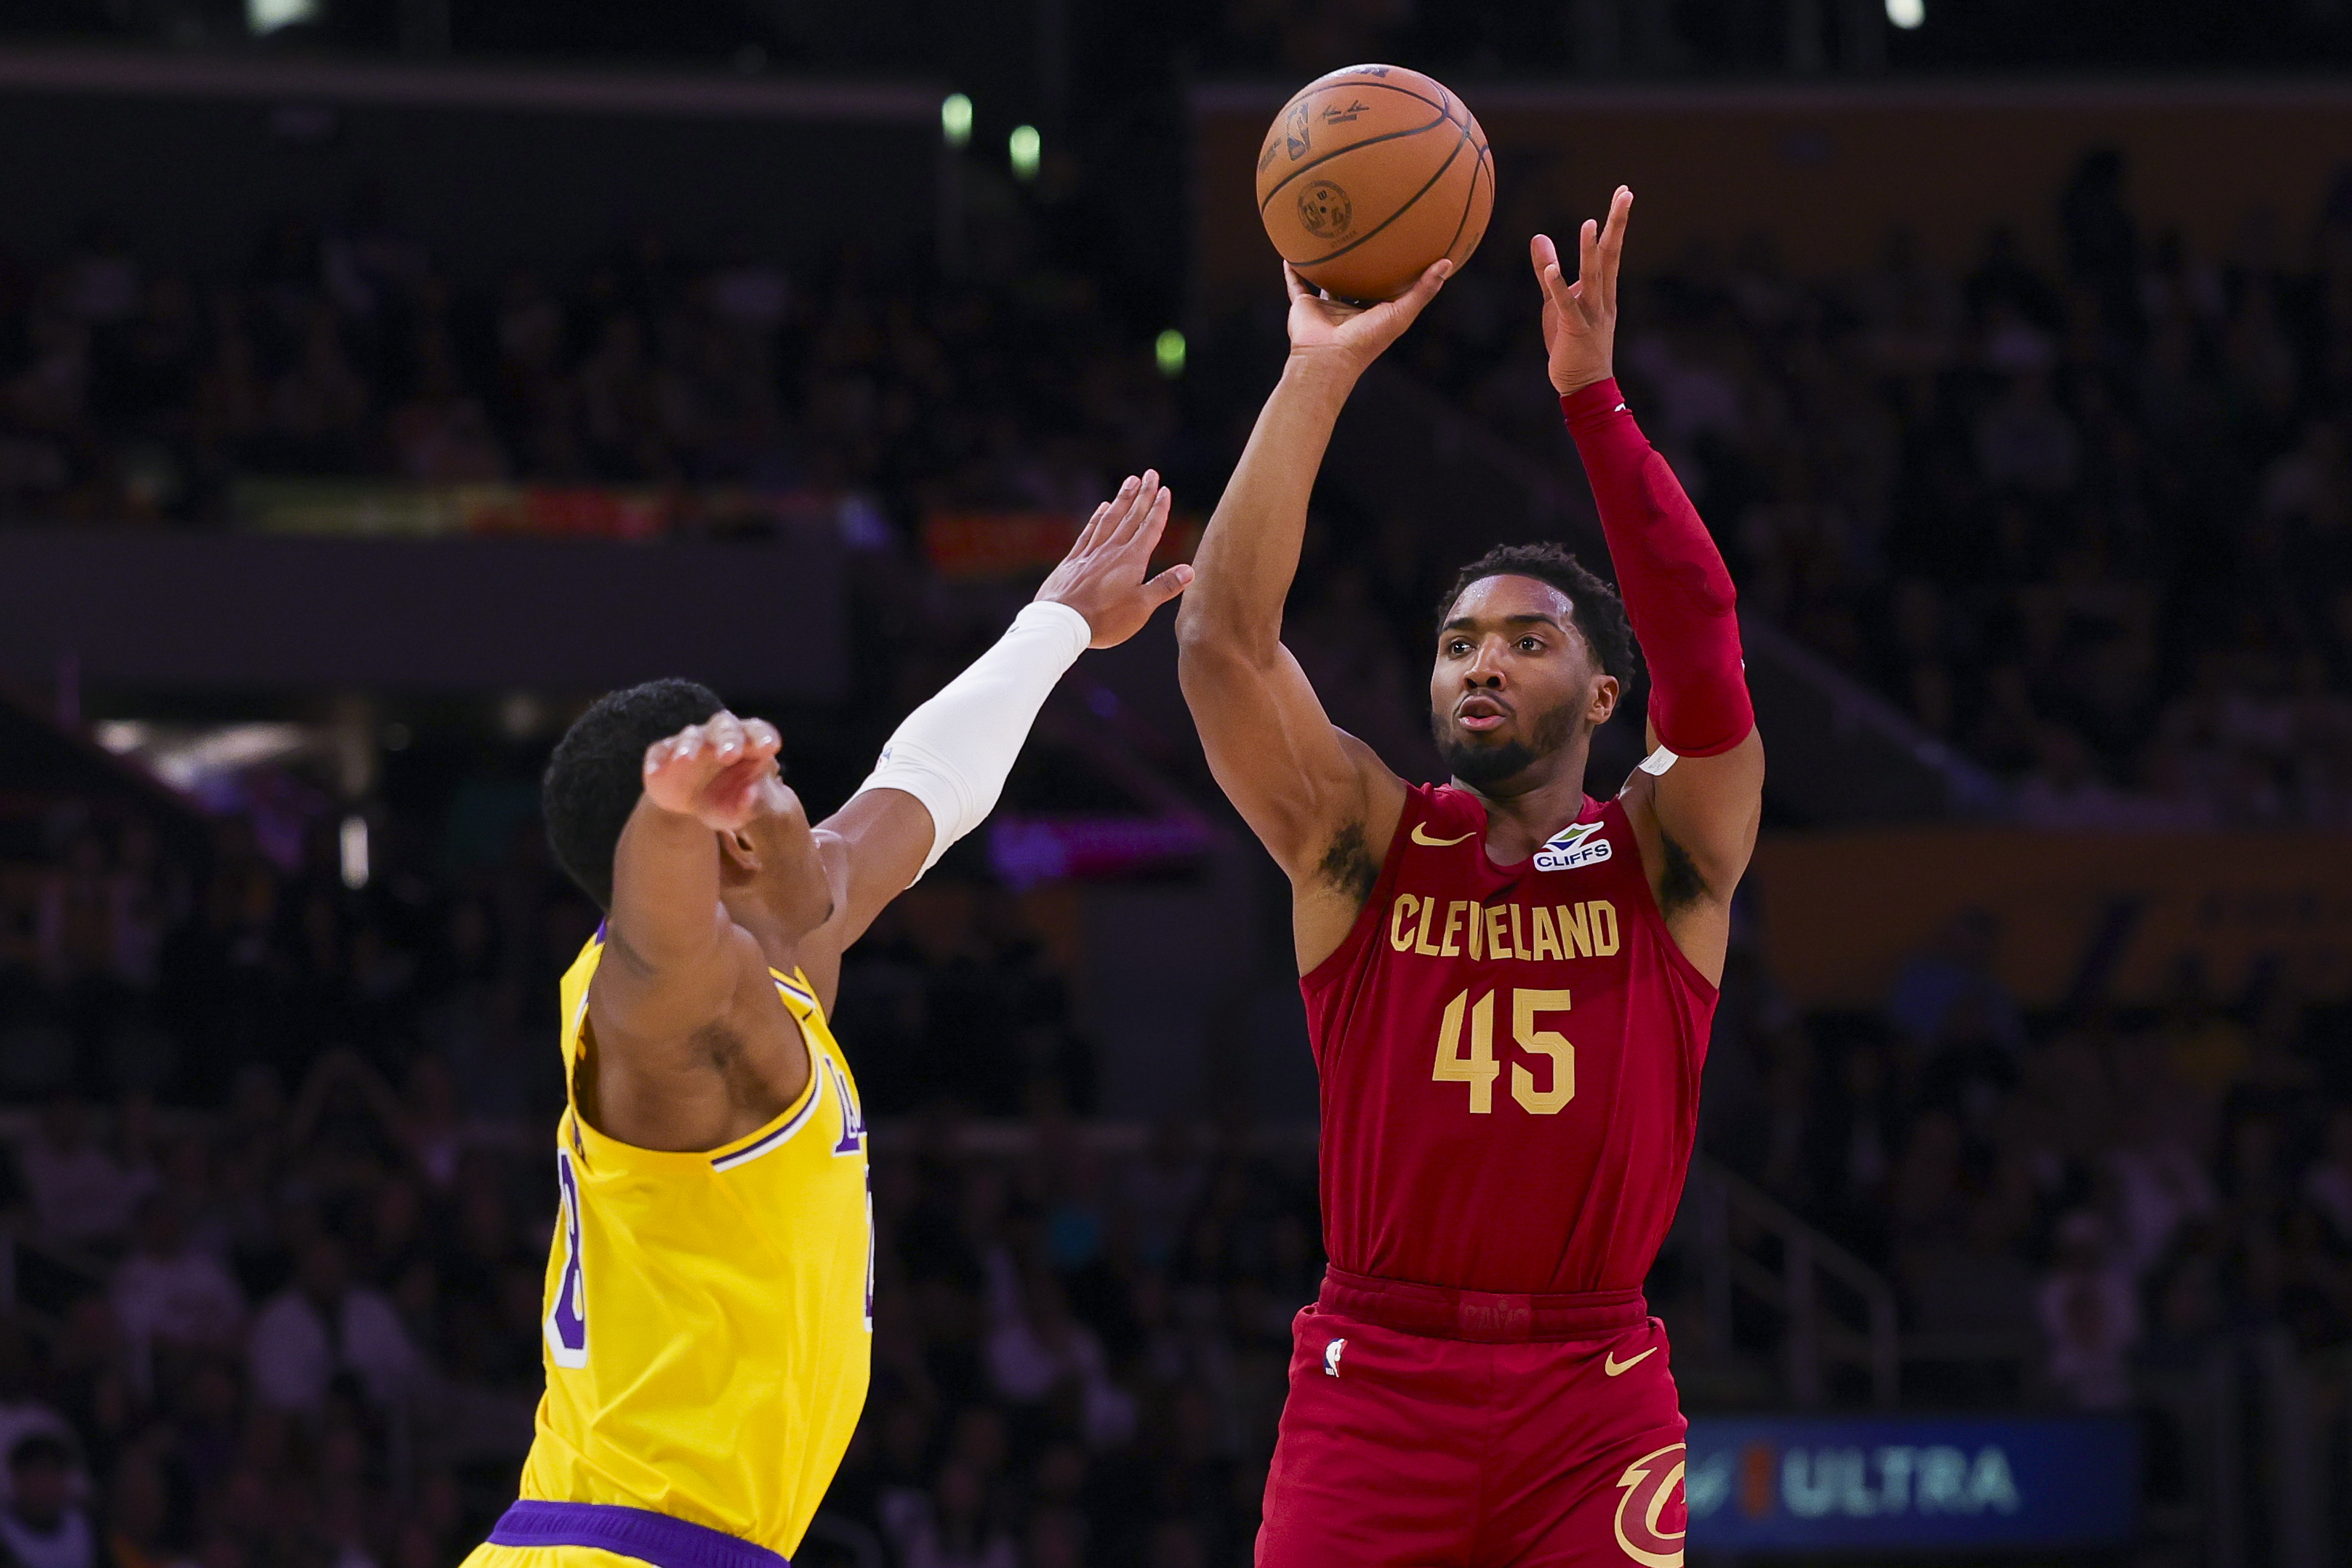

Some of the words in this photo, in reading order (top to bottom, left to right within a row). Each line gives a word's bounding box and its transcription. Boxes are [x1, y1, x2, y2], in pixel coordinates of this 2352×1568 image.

[1536, 843, 1609, 867] CLIFFS
[1390, 893, 1621, 962] CLEVELAND
[1432, 988, 1576, 1115] 45
[1781, 1445, 2020, 1517] ULTRA
